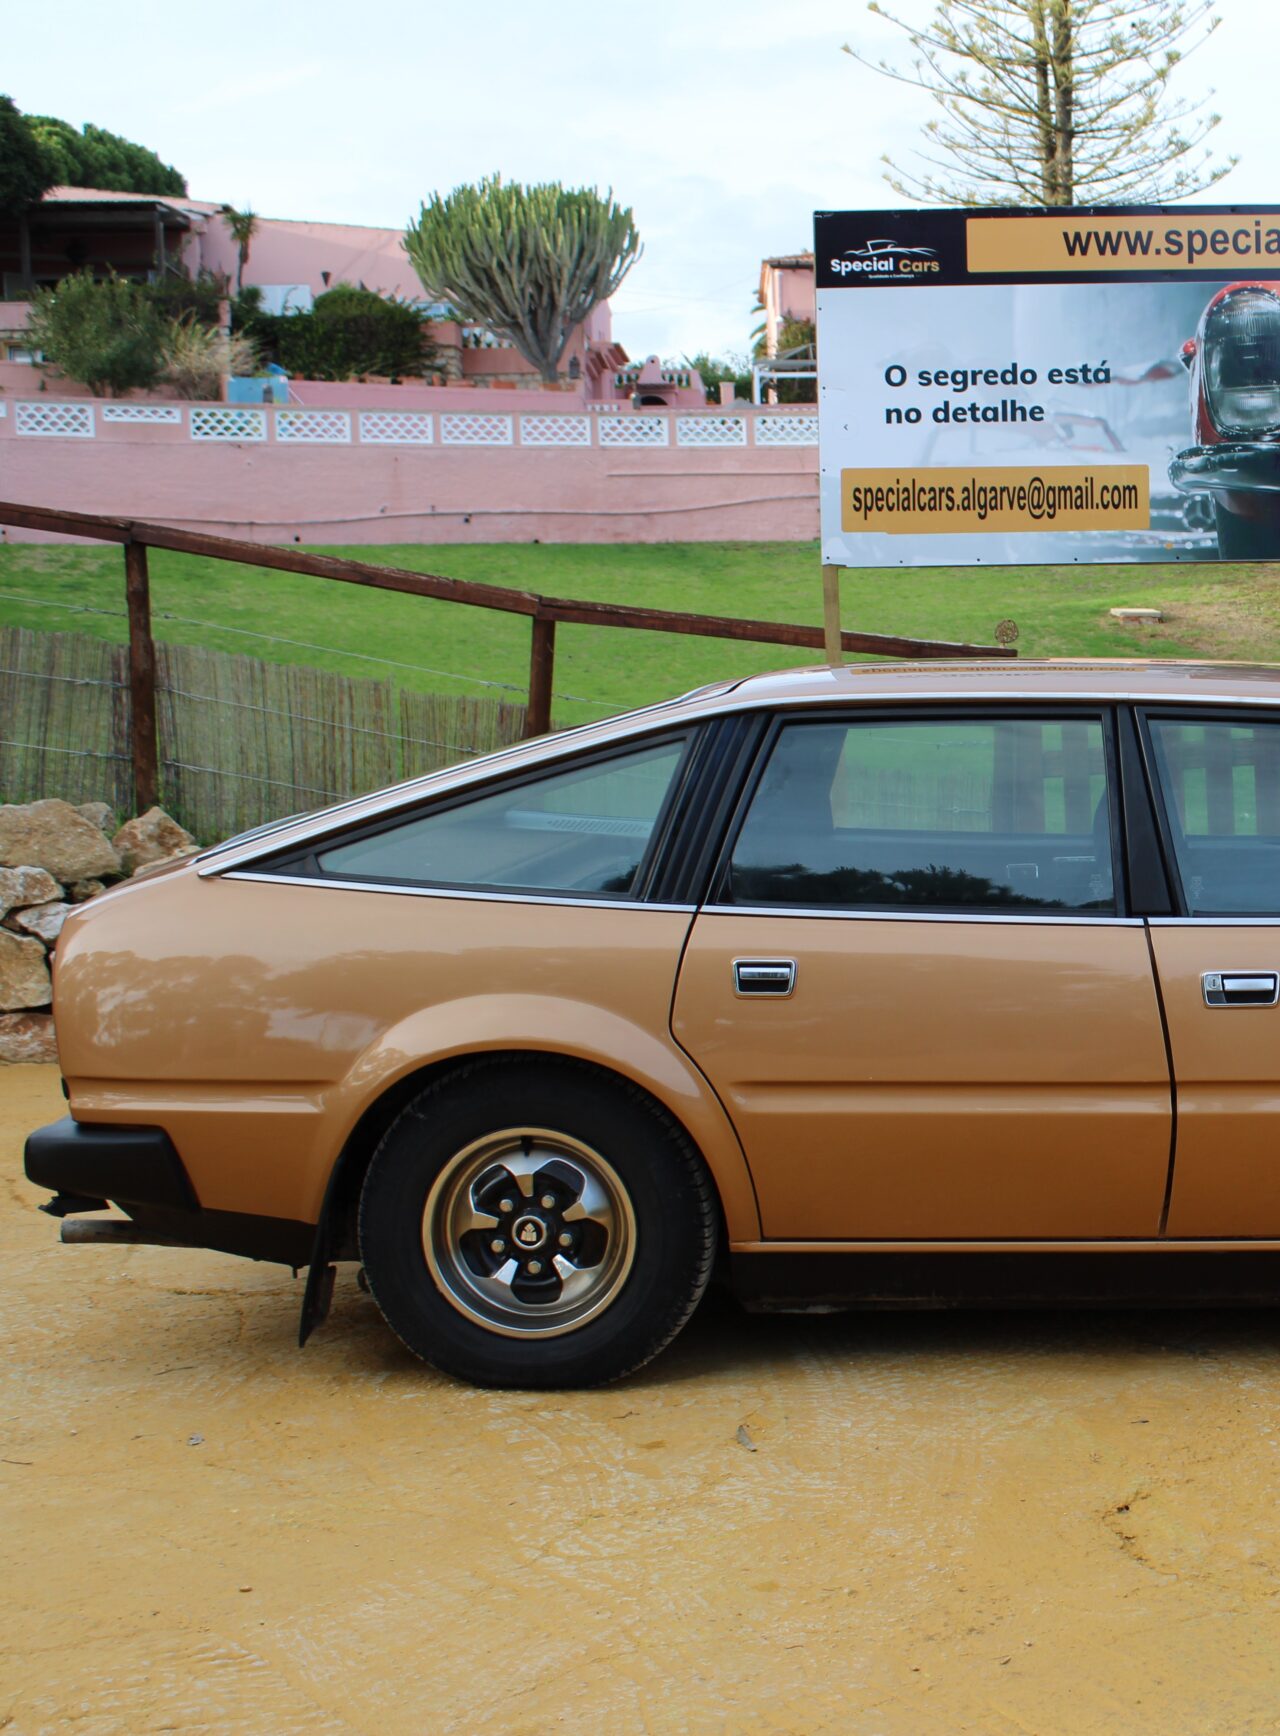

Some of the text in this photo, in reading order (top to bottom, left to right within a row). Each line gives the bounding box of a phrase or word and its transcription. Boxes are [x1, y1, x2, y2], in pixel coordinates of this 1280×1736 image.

[830, 256, 940, 276] Special Cars
[884, 360, 1112, 393] O segredo está
[885, 399, 1045, 424] no detalhe
[852, 476, 1139, 520] specialcars.algarve@gmail.com
